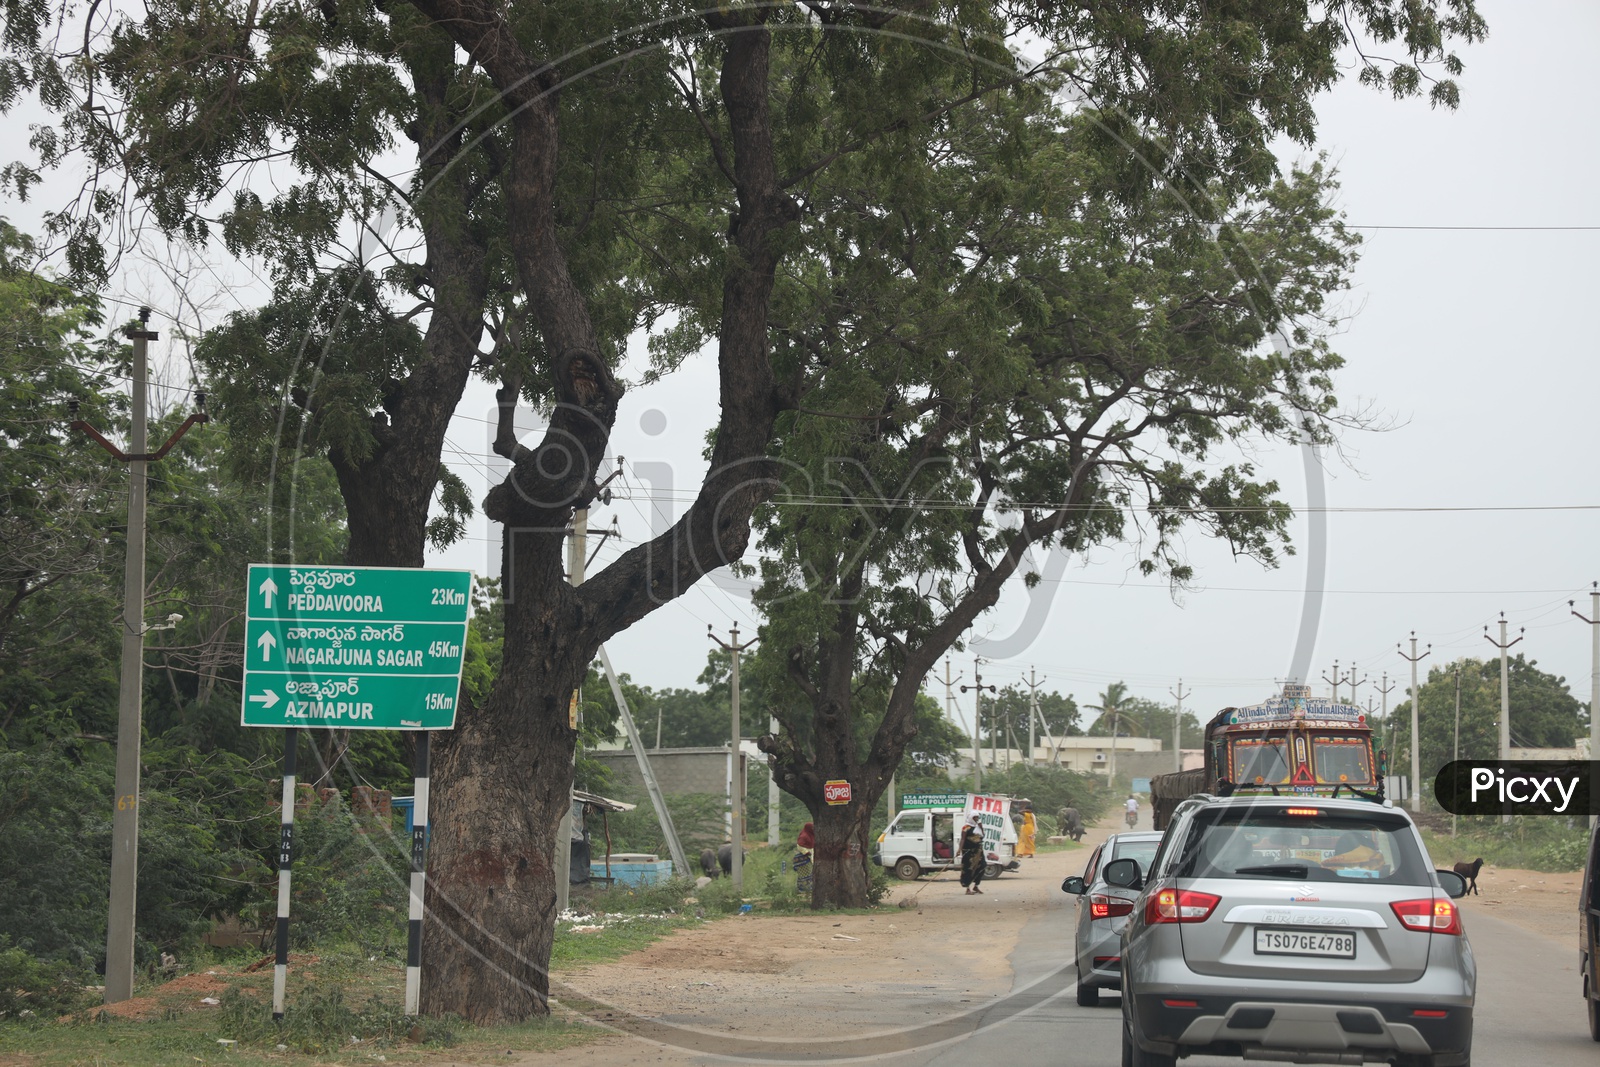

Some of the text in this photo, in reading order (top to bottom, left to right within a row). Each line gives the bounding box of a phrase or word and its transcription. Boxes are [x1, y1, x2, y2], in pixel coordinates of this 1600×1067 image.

[288, 593, 383, 613] PEDDAVOORA
[431, 588, 465, 606] 23Km
[360, 624, 405, 642] సాగర్
[286, 647, 424, 667] NAGARJUNA SAGAR
[428, 641, 460, 658] 45Km
[284, 701, 374, 720] AZMAPUR
[425, 693, 453, 710] 15Km
[117, 794, 136, 811] 67
[972, 796, 1003, 814] RTA
[1262, 914, 1350, 925] BREZZA
[1264, 933, 1352, 952] TS07GE4788
